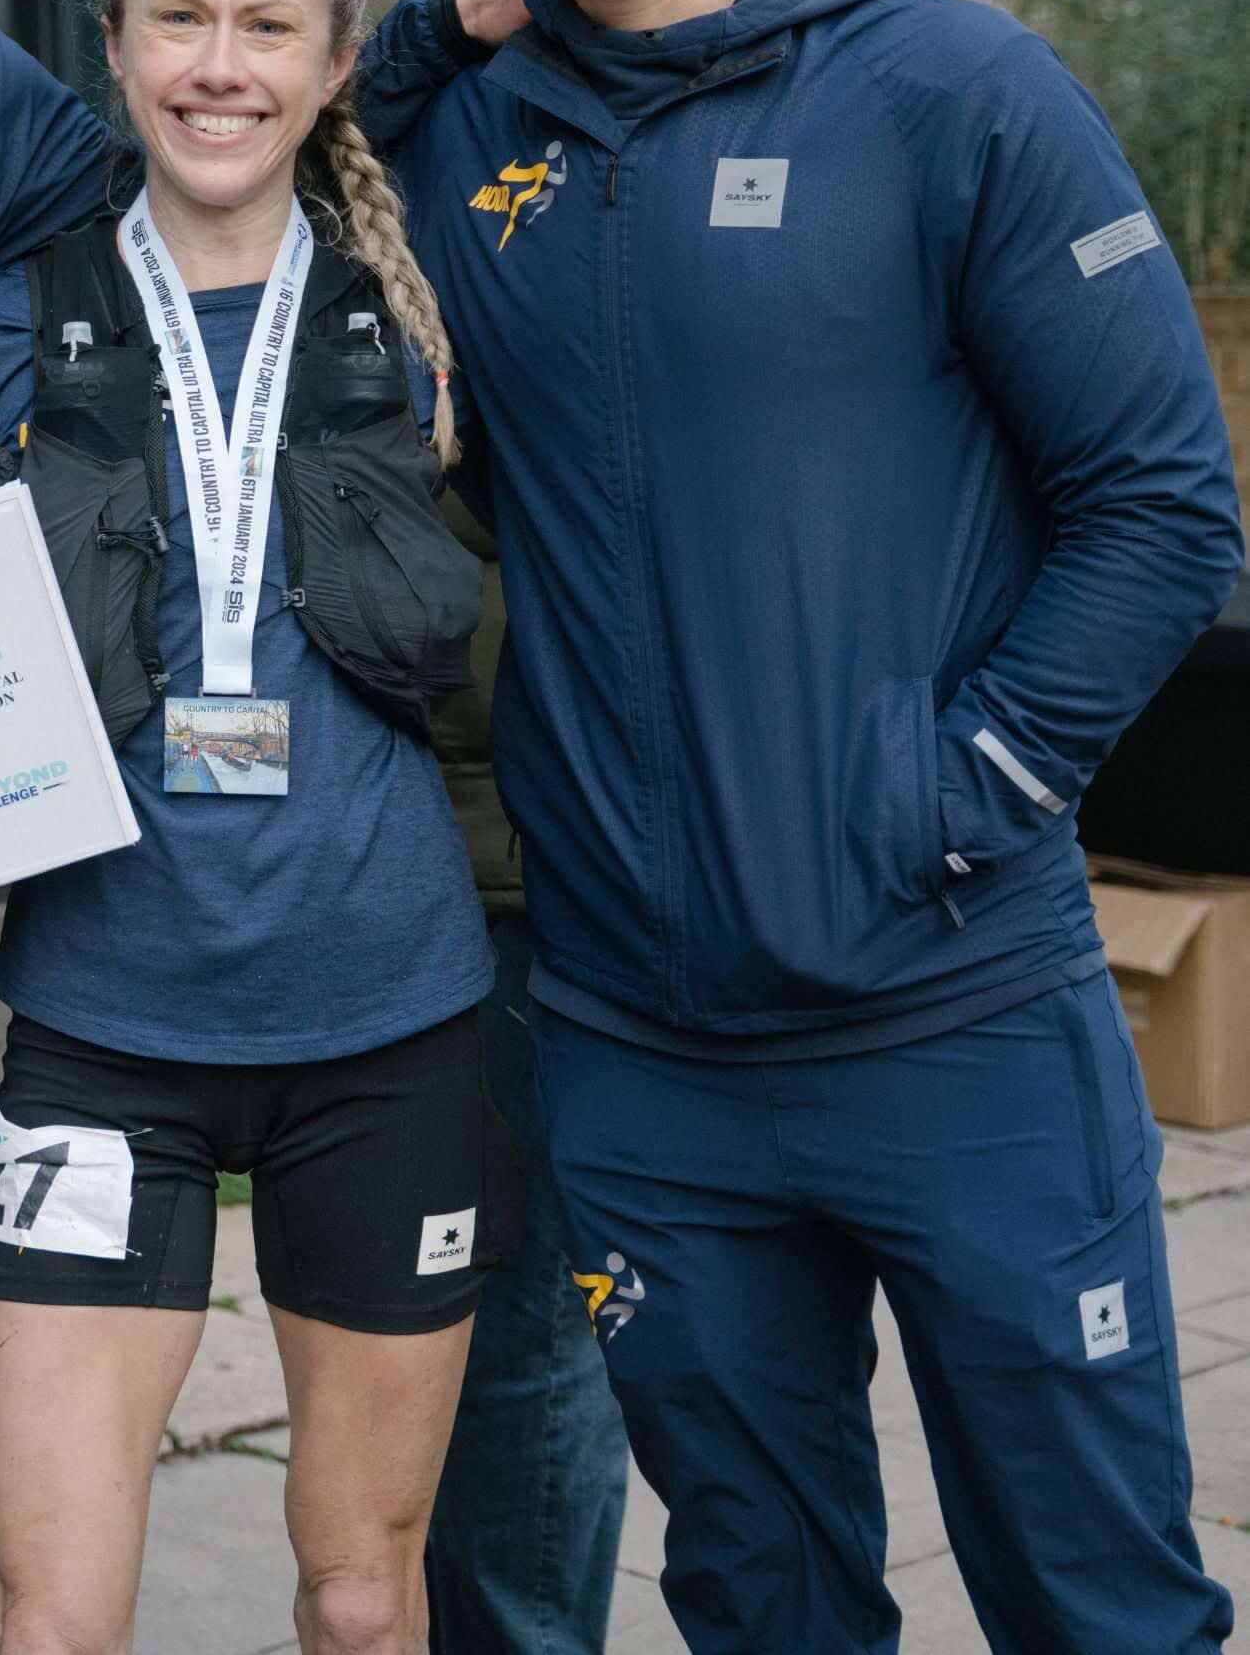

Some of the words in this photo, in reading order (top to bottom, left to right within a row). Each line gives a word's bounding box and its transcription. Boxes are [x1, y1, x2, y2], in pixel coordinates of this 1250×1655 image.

[725, 193, 773, 202] SAYSKY
[140, 247, 160, 274] 2024
[150, 273, 176, 309] JANUARY
[163, 309, 181, 328] 6TH
[265, 301, 292, 353] COUNTRY
[176, 354, 199, 386] ULTRA
[261, 352, 279, 367] TO
[252, 367, 275, 408] CAPITAL
[186, 388, 210, 436] CAPITAL
[246, 410, 267, 444] ULTRA
[195, 439, 212, 455] TO
[198, 457, 222, 514] COUNTRY
[239, 478, 256, 501] 6TH
[234, 502, 254, 552] JANUARY
[230, 554, 247, 584] 2024
